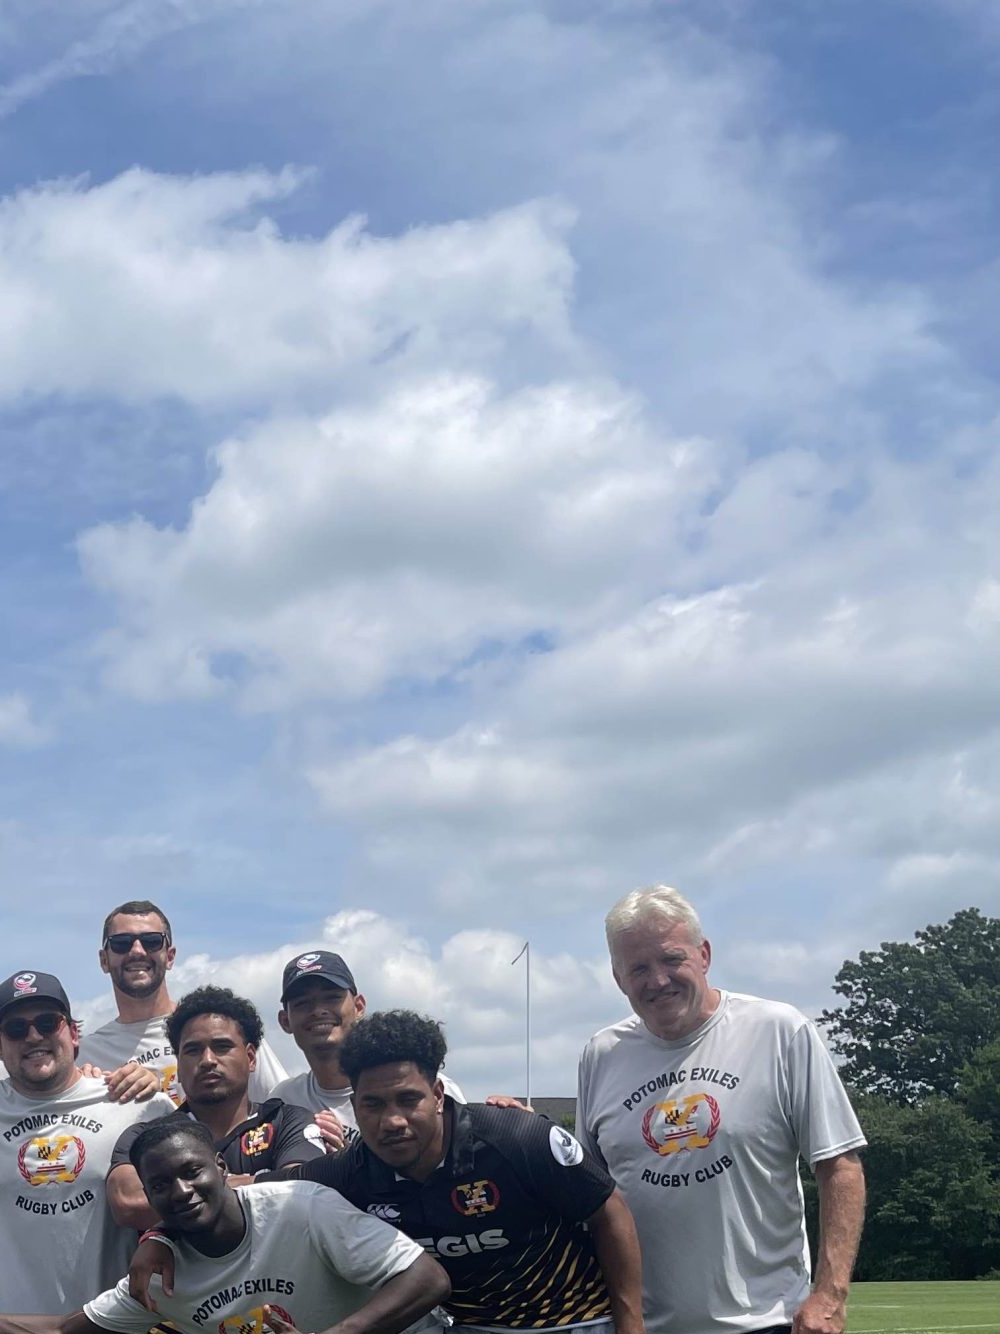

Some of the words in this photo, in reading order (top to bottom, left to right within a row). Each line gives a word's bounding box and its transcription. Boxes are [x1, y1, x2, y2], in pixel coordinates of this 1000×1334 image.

[622, 1070, 687, 1112] POTOMAC
[689, 1067, 740, 1090] EXILES
[3, 1113, 58, 1142] POTOMAC
[60, 1113, 103, 1134] EXILES
[640, 1168, 690, 1188] RUGBY
[695, 1154, 733, 1183] CLUB
[15, 1195, 58, 1215] RUGBY
[61, 1189, 95, 1213] CLUB
[191, 1283, 243, 1327] POTOMAC
[244, 1278, 295, 1297] EXILES
